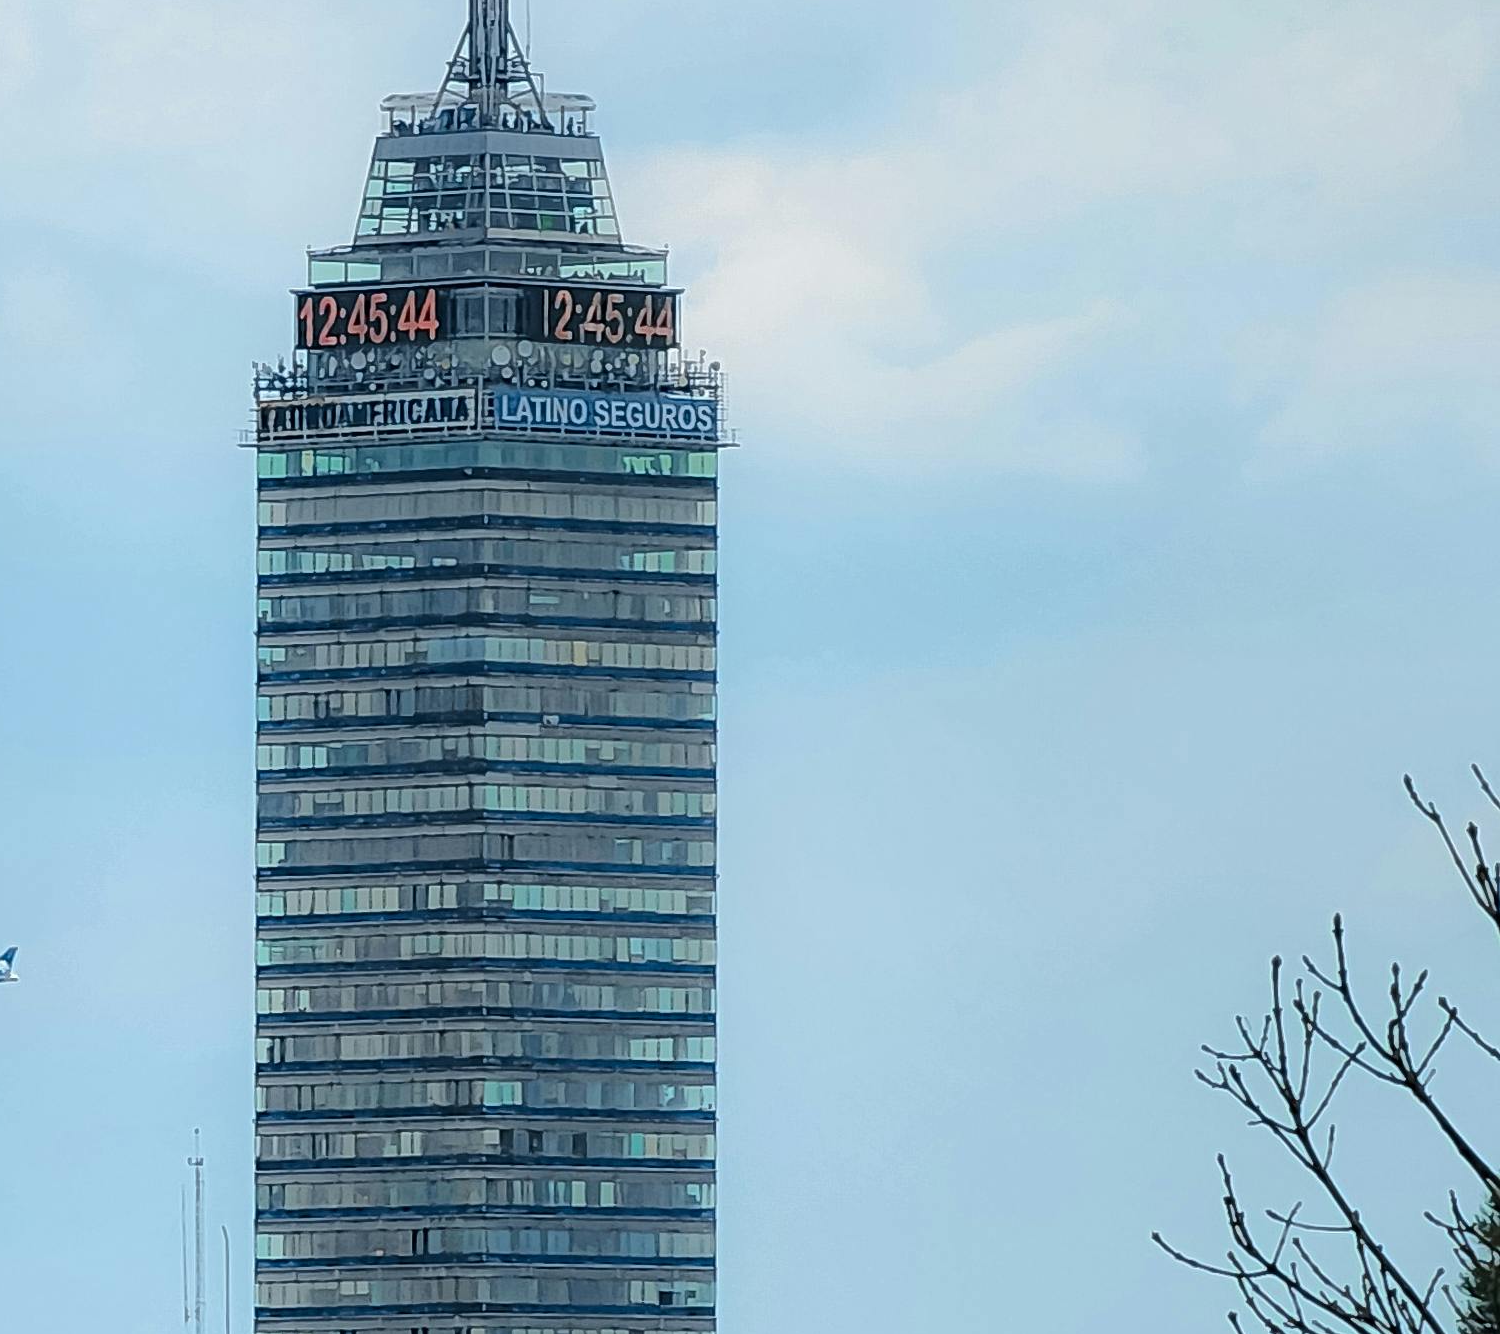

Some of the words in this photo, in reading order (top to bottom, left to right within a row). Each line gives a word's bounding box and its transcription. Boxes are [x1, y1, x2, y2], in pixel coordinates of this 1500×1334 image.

[299, 288, 440, 347] 12:45:44
[501, 394, 588, 425] LATINO
[593, 399, 713, 431] SEGUROS
